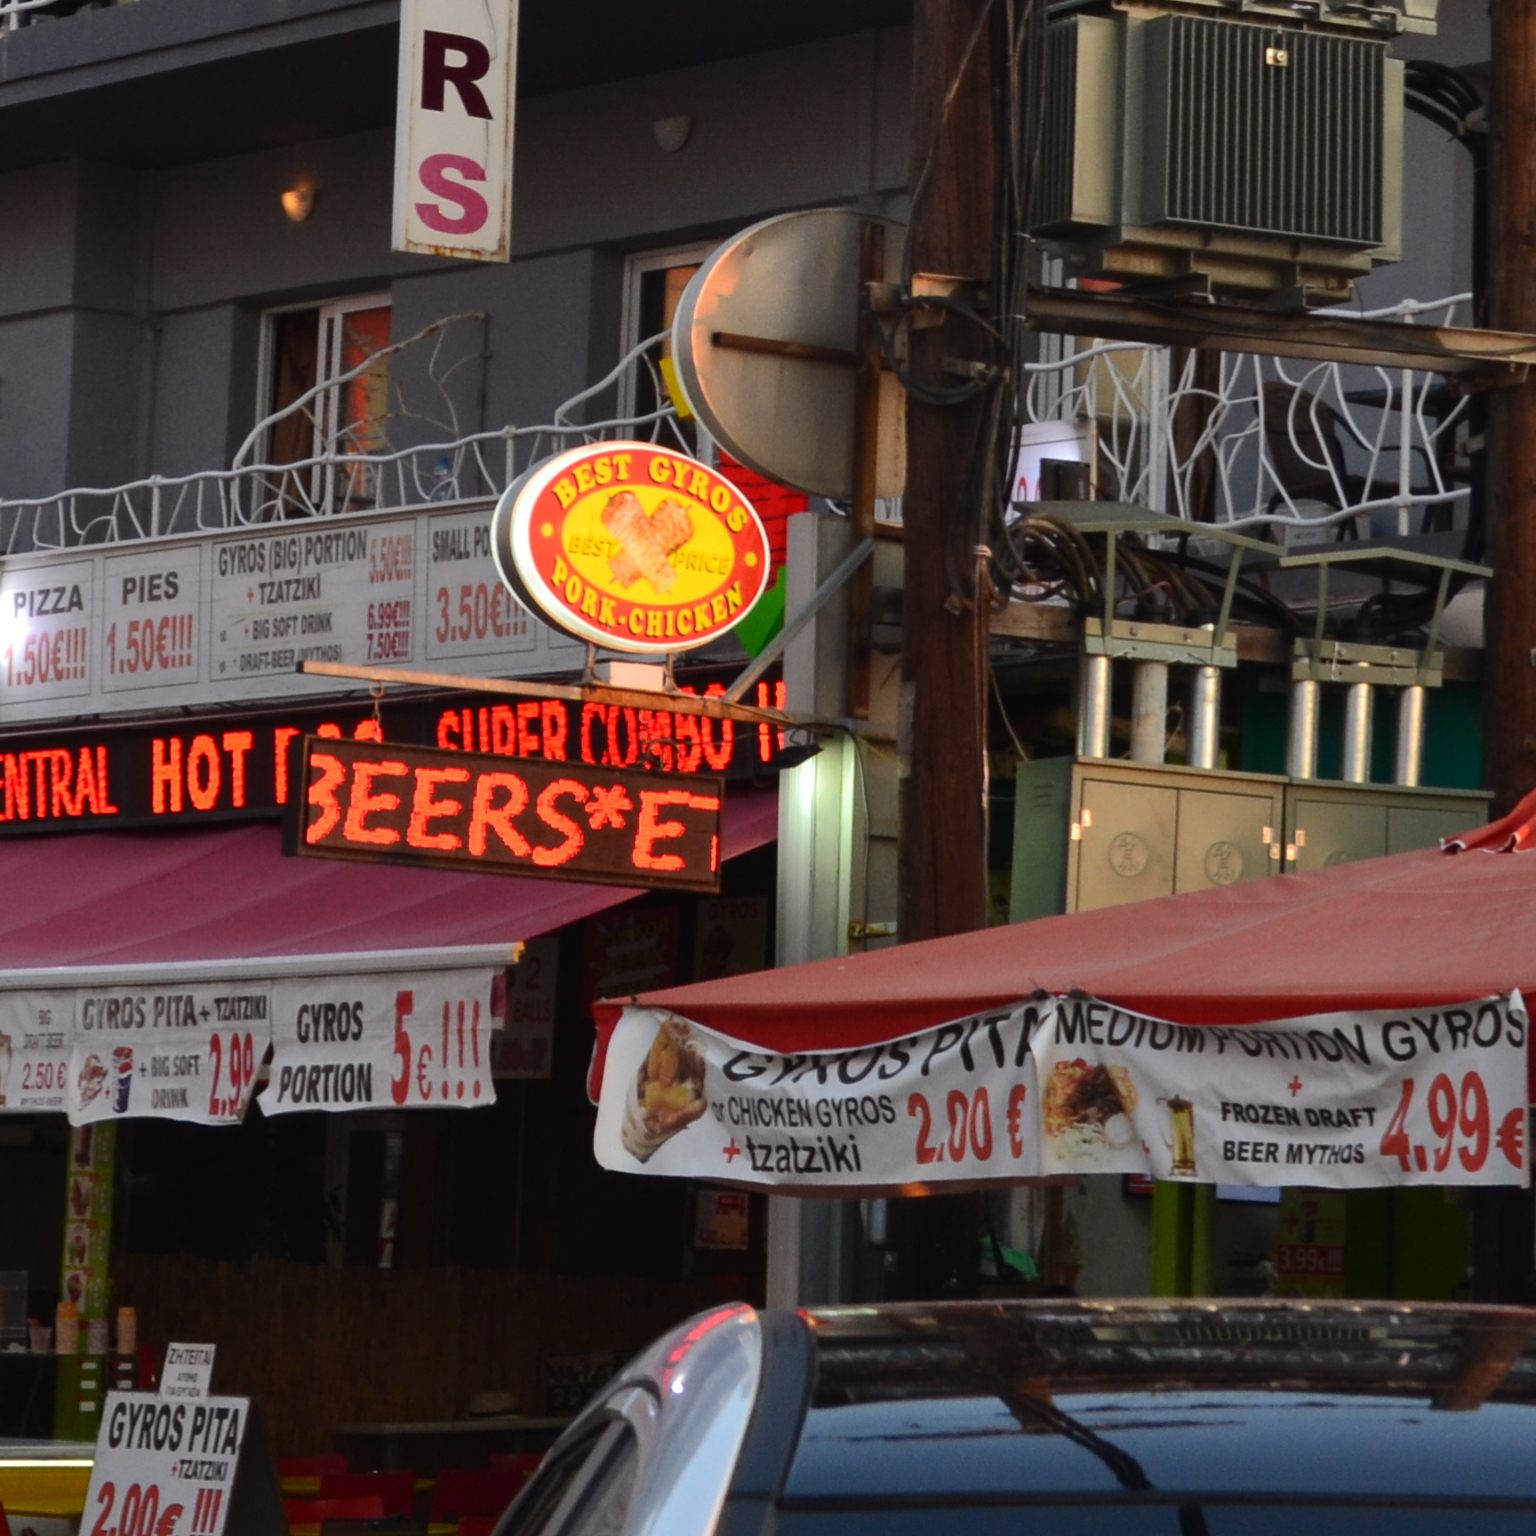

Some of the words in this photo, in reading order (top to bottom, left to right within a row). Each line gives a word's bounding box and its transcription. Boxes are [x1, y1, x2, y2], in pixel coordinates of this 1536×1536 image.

[553, 454, 632, 509] BEST
[649, 456, 748, 534] GYROS
[219, 543, 265, 576] GYROS
[269, 536, 302, 578] (BIG)
[305, 530, 367, 566] PORTION
[433, 528, 470, 562] SMALL
[568, 535, 618, 559] BEST
[672, 547, 731, 575] PRICE
[14, 584, 83, 618] PIZZA
[122, 571, 179, 605] PIES
[107, 614, 193, 675] 1.50€!!!
[253, 618, 269, 640] BIG
[272, 616, 298, 637] SOFT
[301, 612, 333, 635] DRINK
[437, 699, 568, 761] SUPER
[152, 731, 254, 813] HOT
[83, 996, 146, 1030] GYROS
[153, 995, 198, 1027] PITA
[213, 995, 267, 1021] TZATZIKI
[297, 1001, 363, 1044] GYROS
[1055, 1002, 1205, 1052] MEDIUM
[1215, 1027, 1371, 1065] PORTION
[1382, 1003, 1525, 1061] GYROS
[152, 1056, 169, 1076] BIG
[174, 1055, 200, 1076] SOFT
[277, 1063, 373, 1103] PORTION
[152, 1088, 189, 1109] DRINK
[728, 1098, 812, 1129] CHICKEN
[817, 1095, 896, 1126] GYROS
[1221, 1102, 1300, 1127] FROZEN
[1306, 1106, 1376, 1127] DRAFT
[907, 1087, 994, 1164] 2.00
[746, 1135, 863, 1173] tzatziki
[1223, 1140, 1277, 1163] BEER
[1285, 1143, 1364, 1165] MYTHOS
[108, 1402, 186, 1452] GYROS
[188, 1406, 240, 1455] PITA
[178, 1459, 228, 1481] TZATZIKI
